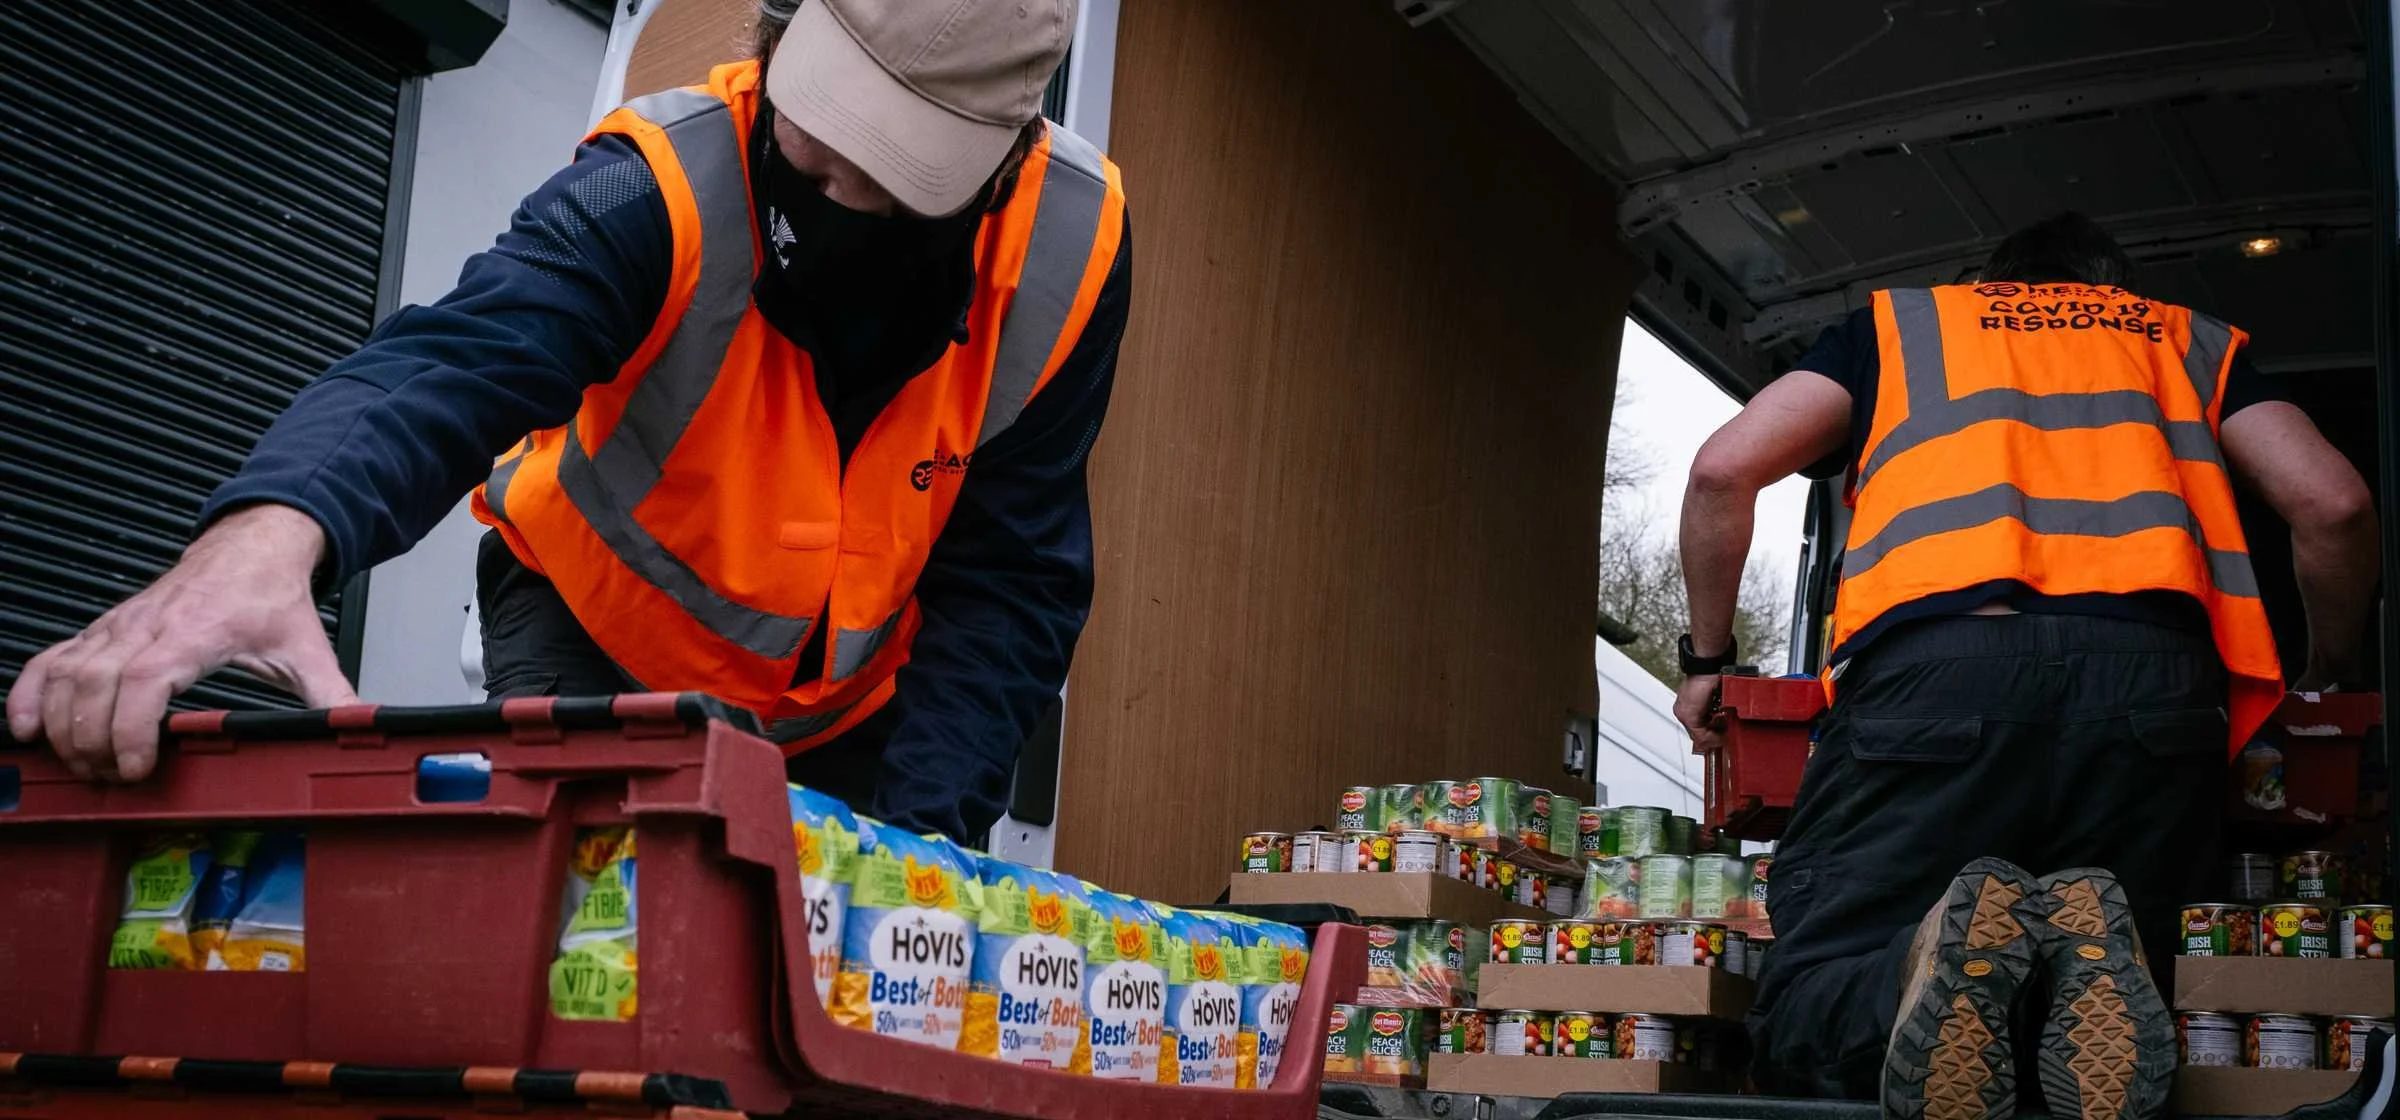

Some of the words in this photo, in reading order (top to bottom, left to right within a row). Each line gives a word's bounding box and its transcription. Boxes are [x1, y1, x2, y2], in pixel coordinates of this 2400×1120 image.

[1980, 314, 2163, 342] RESPONSE
[2275, 920, 2299, 929] £1.89
[892, 926, 964, 967] HOVIS
[2187, 936, 2211, 949] IRISH
[2301, 935, 2329, 949] IRISH
[1019, 952, 1078, 990] HOVIS
[1368, 958, 1394, 967] LICES
[563, 967, 593, 997] VIT
[596, 968, 608, 997] D
[871, 971, 918, 1006] Best
[918, 978, 935, 1006] of
[1107, 979, 1160, 1011] HOVIS
[999, 992, 1039, 1025] Best
[1038, 999, 1053, 1025] of
[1192, 997, 1236, 1026] HOVIS
[1271, 998, 1298, 1025] HOV
[1091, 1017, 1126, 1046] Best
[1126, 1020, 1139, 1045] of
[1259, 1031, 1279, 1057] Best
[1327, 1036, 1346, 1045] ACH
[1372, 1037, 1402, 1047] PEACH
[1178, 1034, 1208, 1060] Best
[1327, 1045, 1346, 1054] ICES
[1371, 1046, 1402, 1056] SLICES
